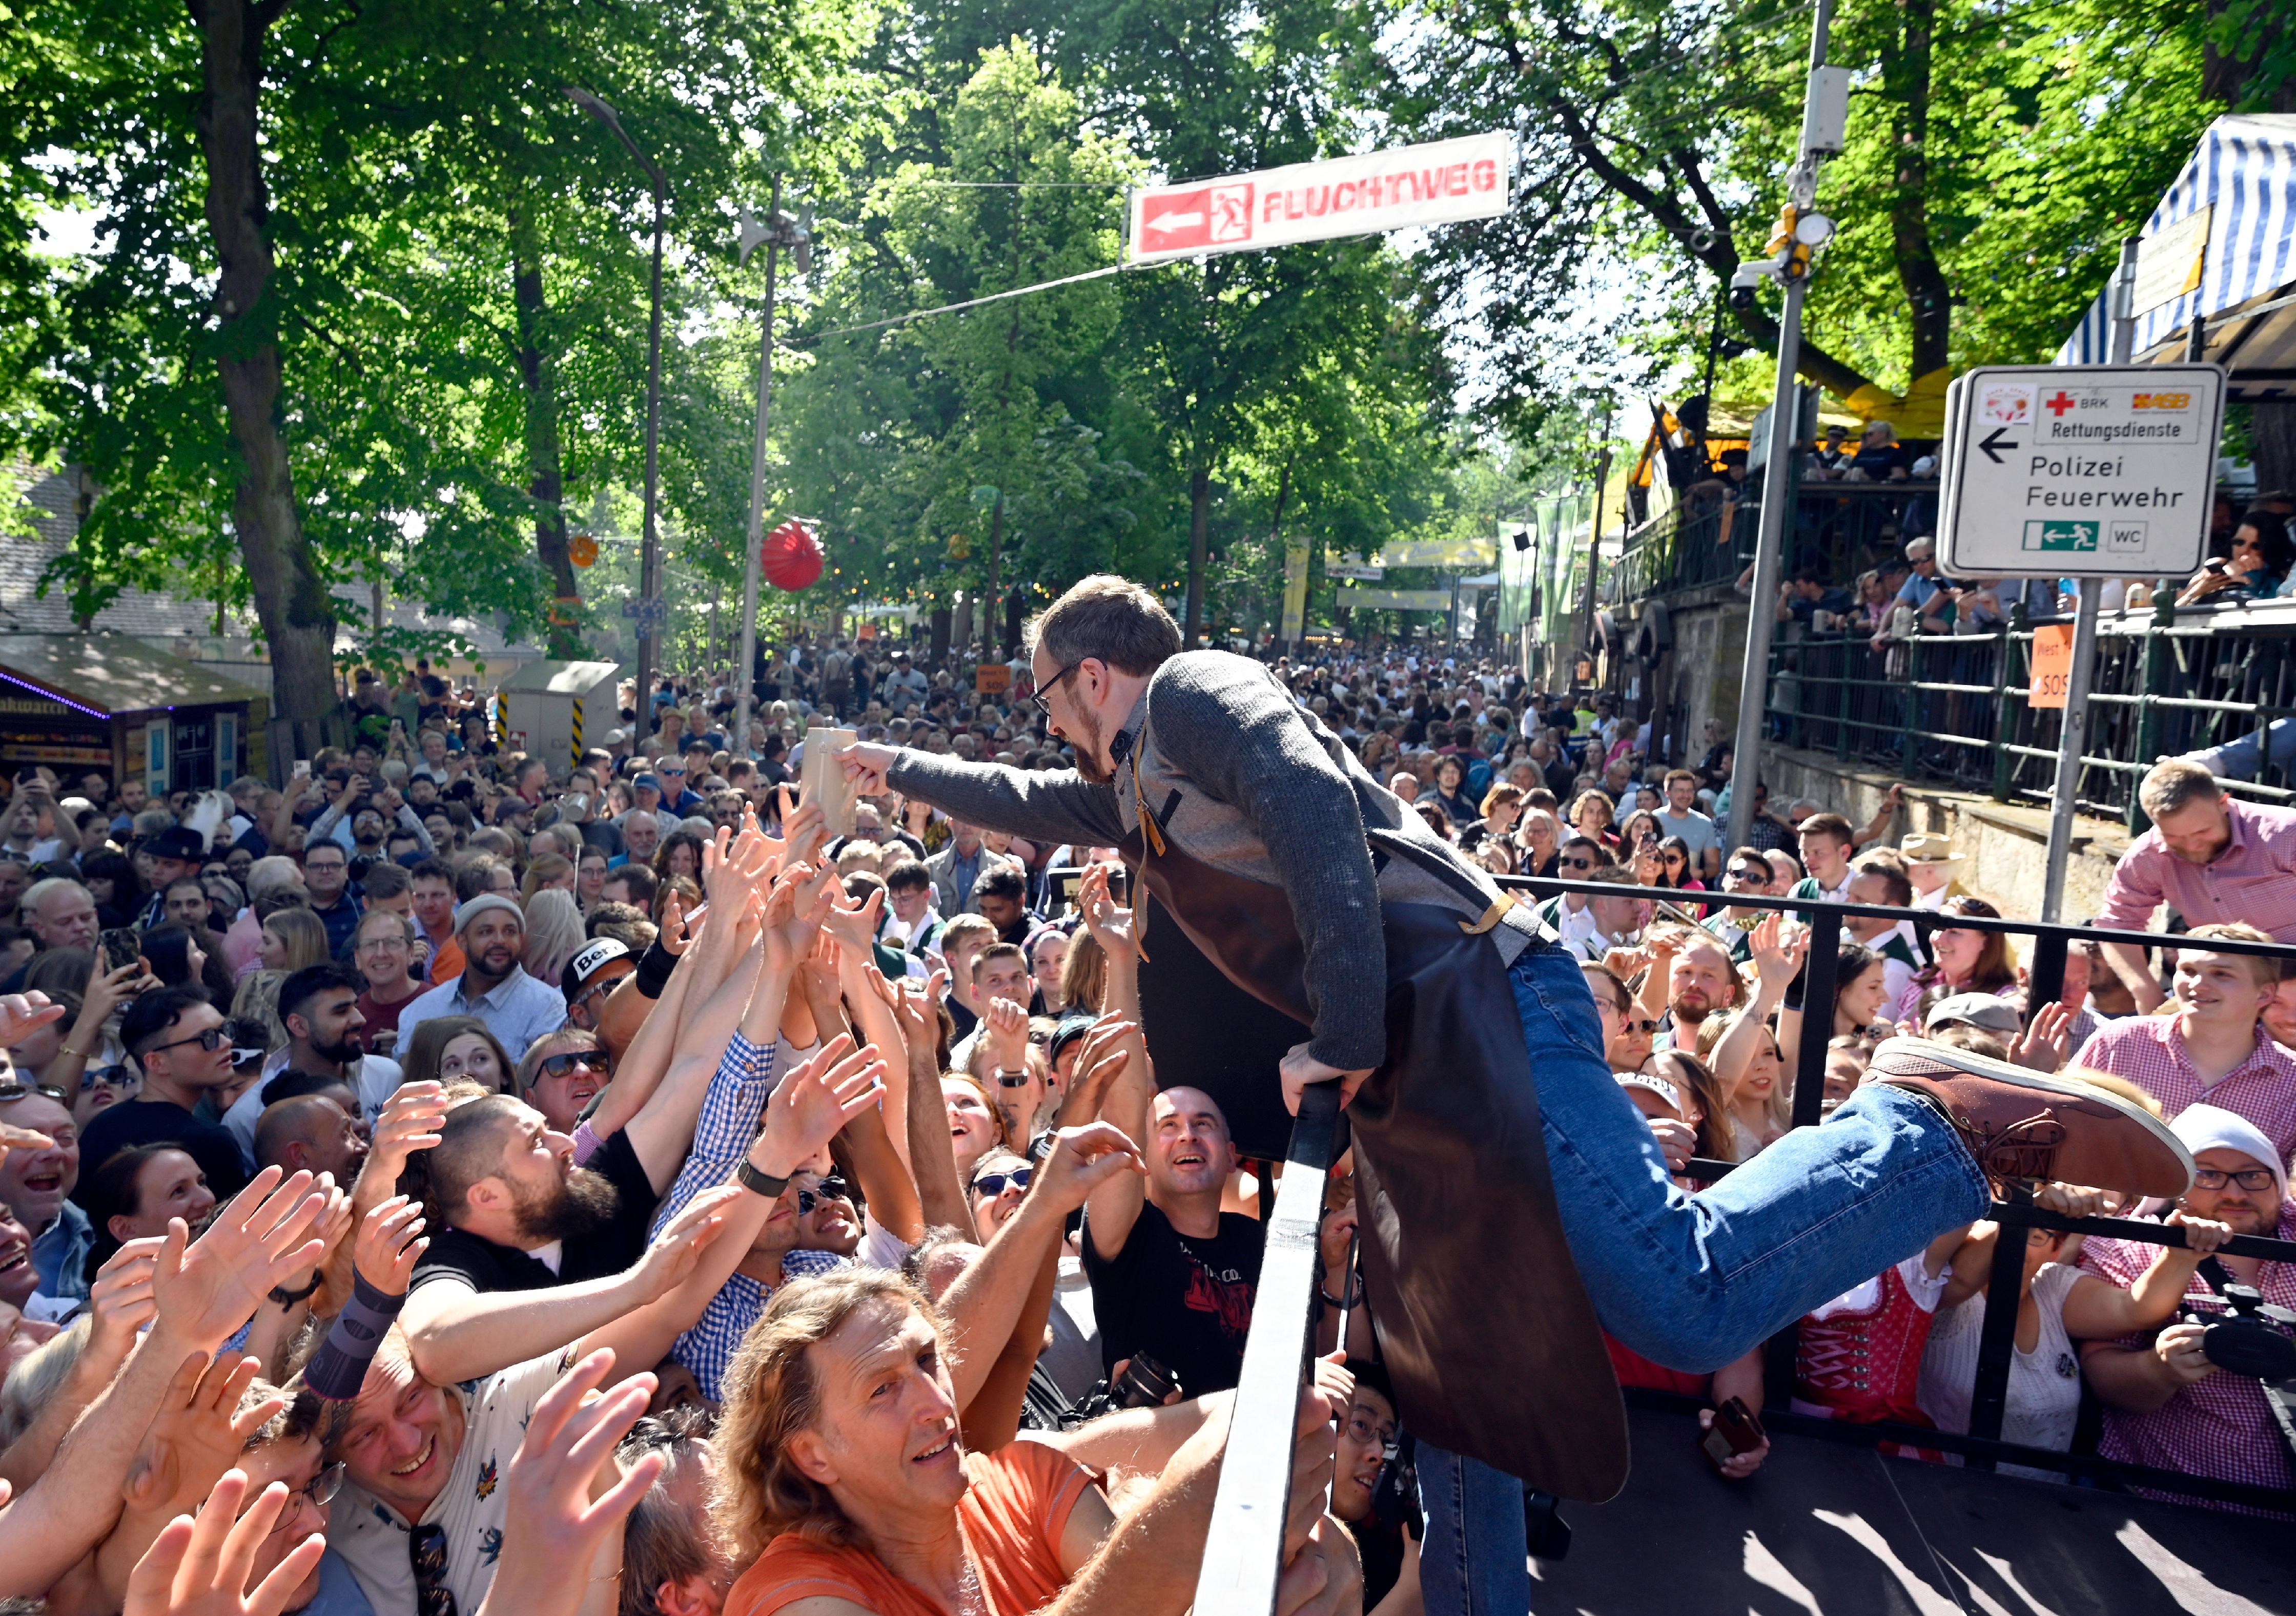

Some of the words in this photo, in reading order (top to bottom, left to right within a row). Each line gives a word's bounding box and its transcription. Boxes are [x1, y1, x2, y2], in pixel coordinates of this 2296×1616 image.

[1263, 159, 1497, 222] FLUCHTWEG
[2080, 398, 2109, 409] BRK
[2150, 392, 2191, 409] ASB
[2052, 421, 2181, 441] Rettungsdienste
[2029, 456, 2124, 477] Polizei
[2026, 486, 2184, 507] Feuerwehr
[2114, 530, 2141, 543] WC
[2043, 674, 2068, 695] SOS
